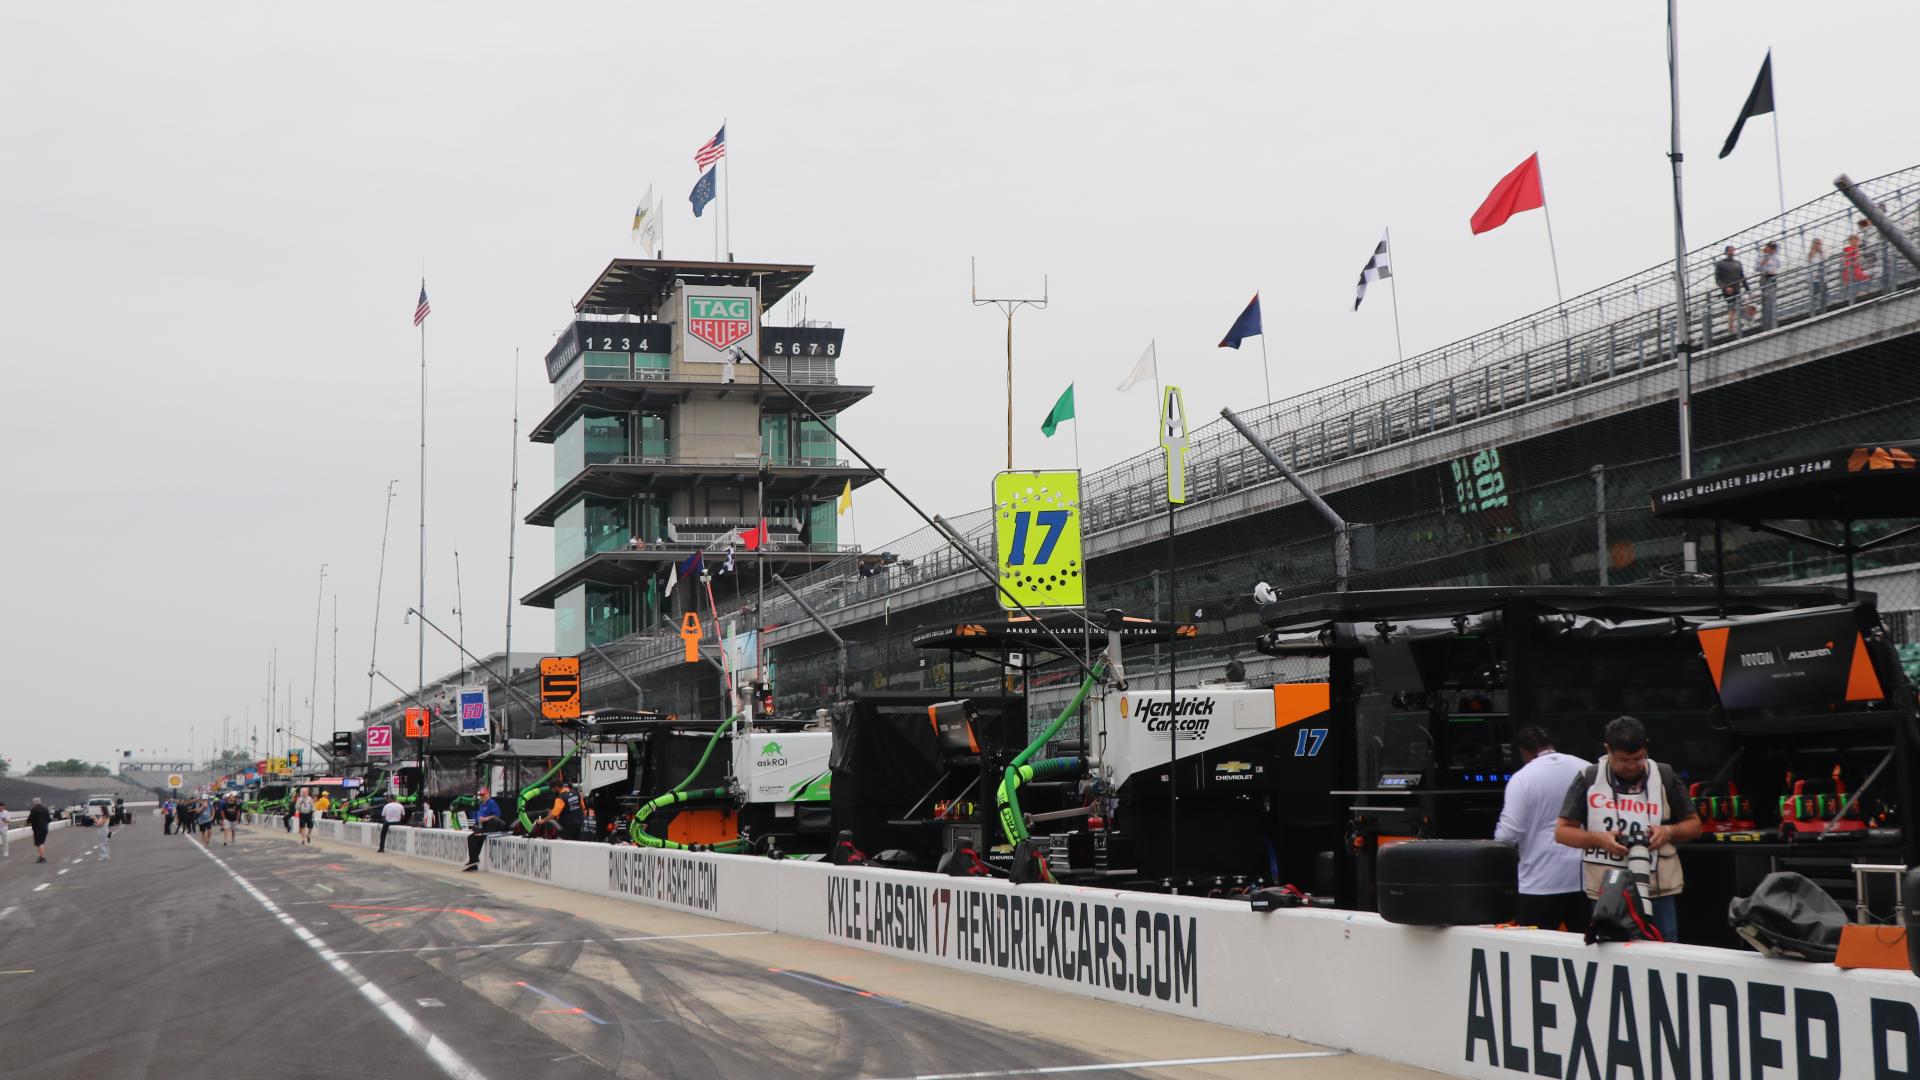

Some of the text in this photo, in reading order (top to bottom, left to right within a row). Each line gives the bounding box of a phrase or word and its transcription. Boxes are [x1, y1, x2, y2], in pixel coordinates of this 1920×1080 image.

[694, 300, 745, 318] TAG
[586, 337, 649, 351] 1 2 3 4
[692, 320, 748, 346] HEUER
[774, 342, 835, 356] 5 6 7 8
[1745, 465, 1796, 485] INDYCAR
[1799, 459, 1832, 474] TEAM
[1007, 509, 1069, 566] 17
[543, 674, 578, 703] 5
[1134, 696, 1216, 723] Hendrick
[368, 729, 391, 745] 27
[1294, 728, 1329, 757] 17
[757, 758, 788, 767] askROI
[1589, 792, 1659, 816] Canon
[629, 852, 656, 898] VEEKAY
[657, 855, 665, 901] 21
[666, 856, 718, 913] ASKROI.COM
[828, 875, 1198, 1008] KYLE LARSON 17 HENDRICKCARS.COM
[1465, 947, 1841, 1080] ALEXANDER
